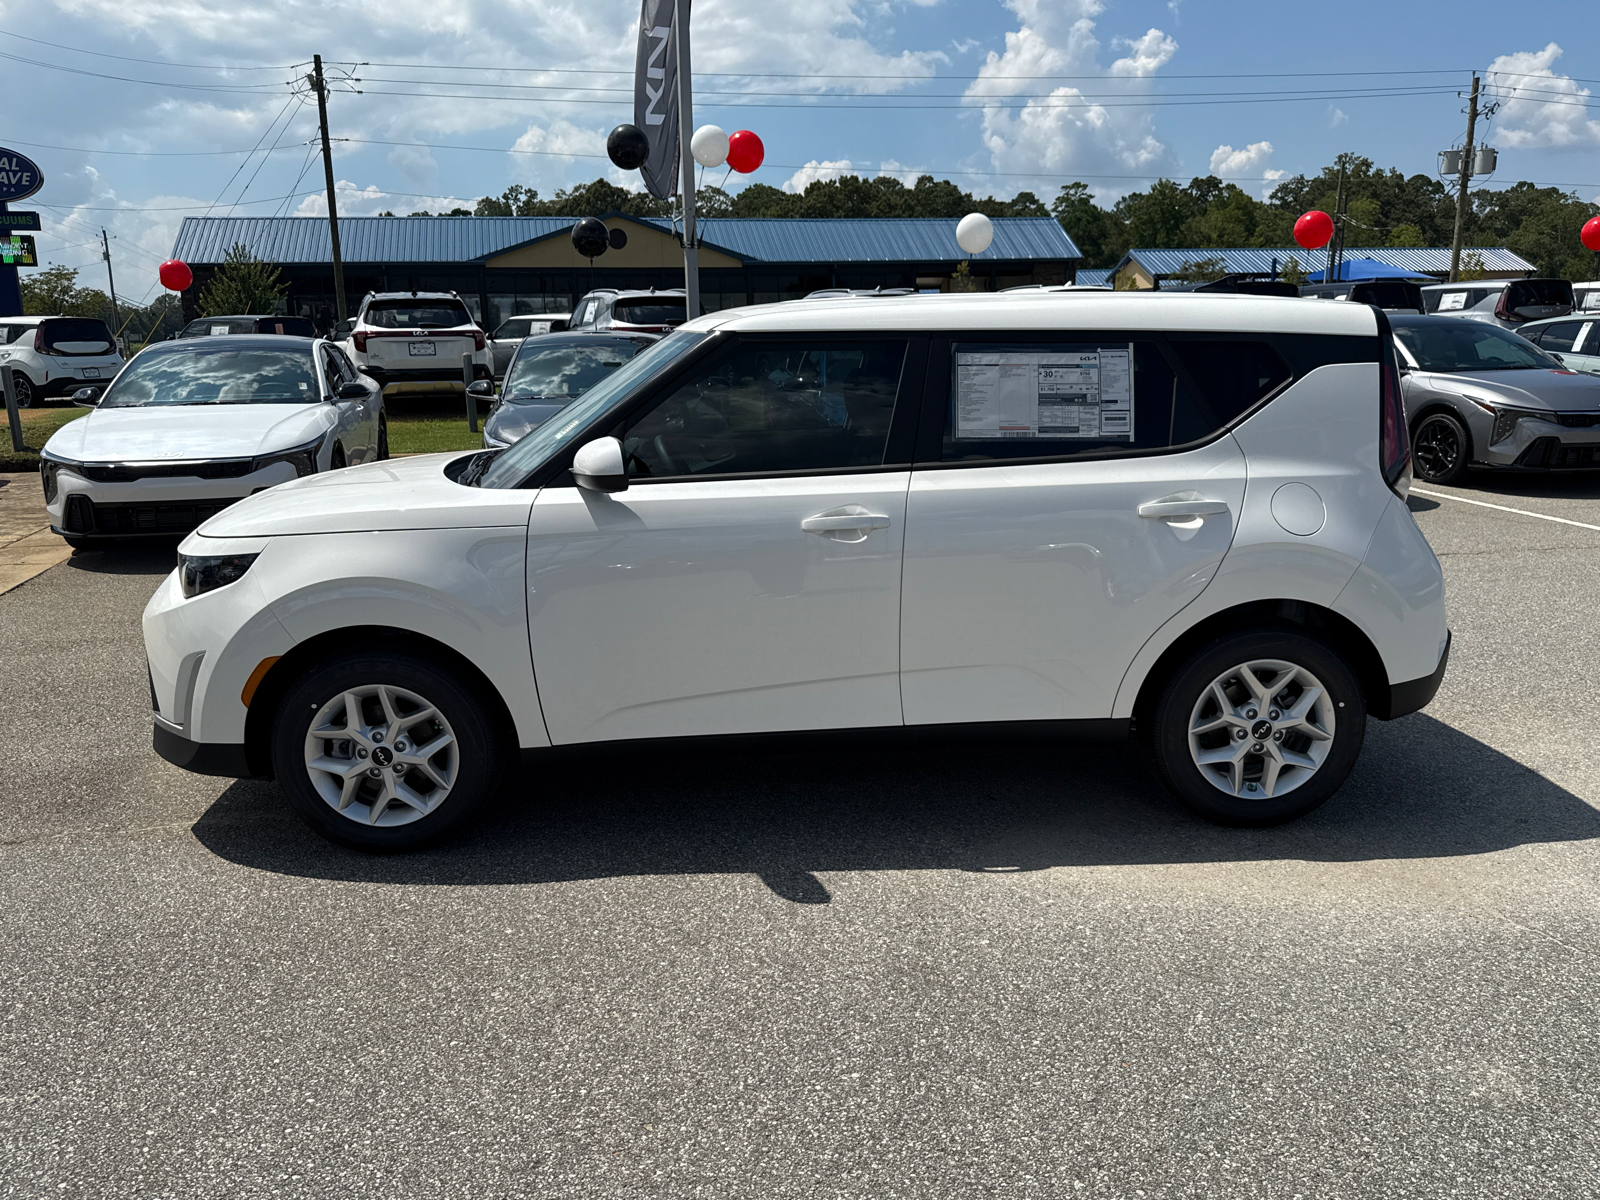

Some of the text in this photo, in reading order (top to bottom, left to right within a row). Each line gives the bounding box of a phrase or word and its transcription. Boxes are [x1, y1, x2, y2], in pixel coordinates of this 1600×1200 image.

[0, 215, 33, 225] UUMS
[1043, 370, 1054, 378] 30
[333, 662, 433, 685] NEXEN
[1255, 723, 1270, 738] KIA
[375, 748, 388, 765] KIA
